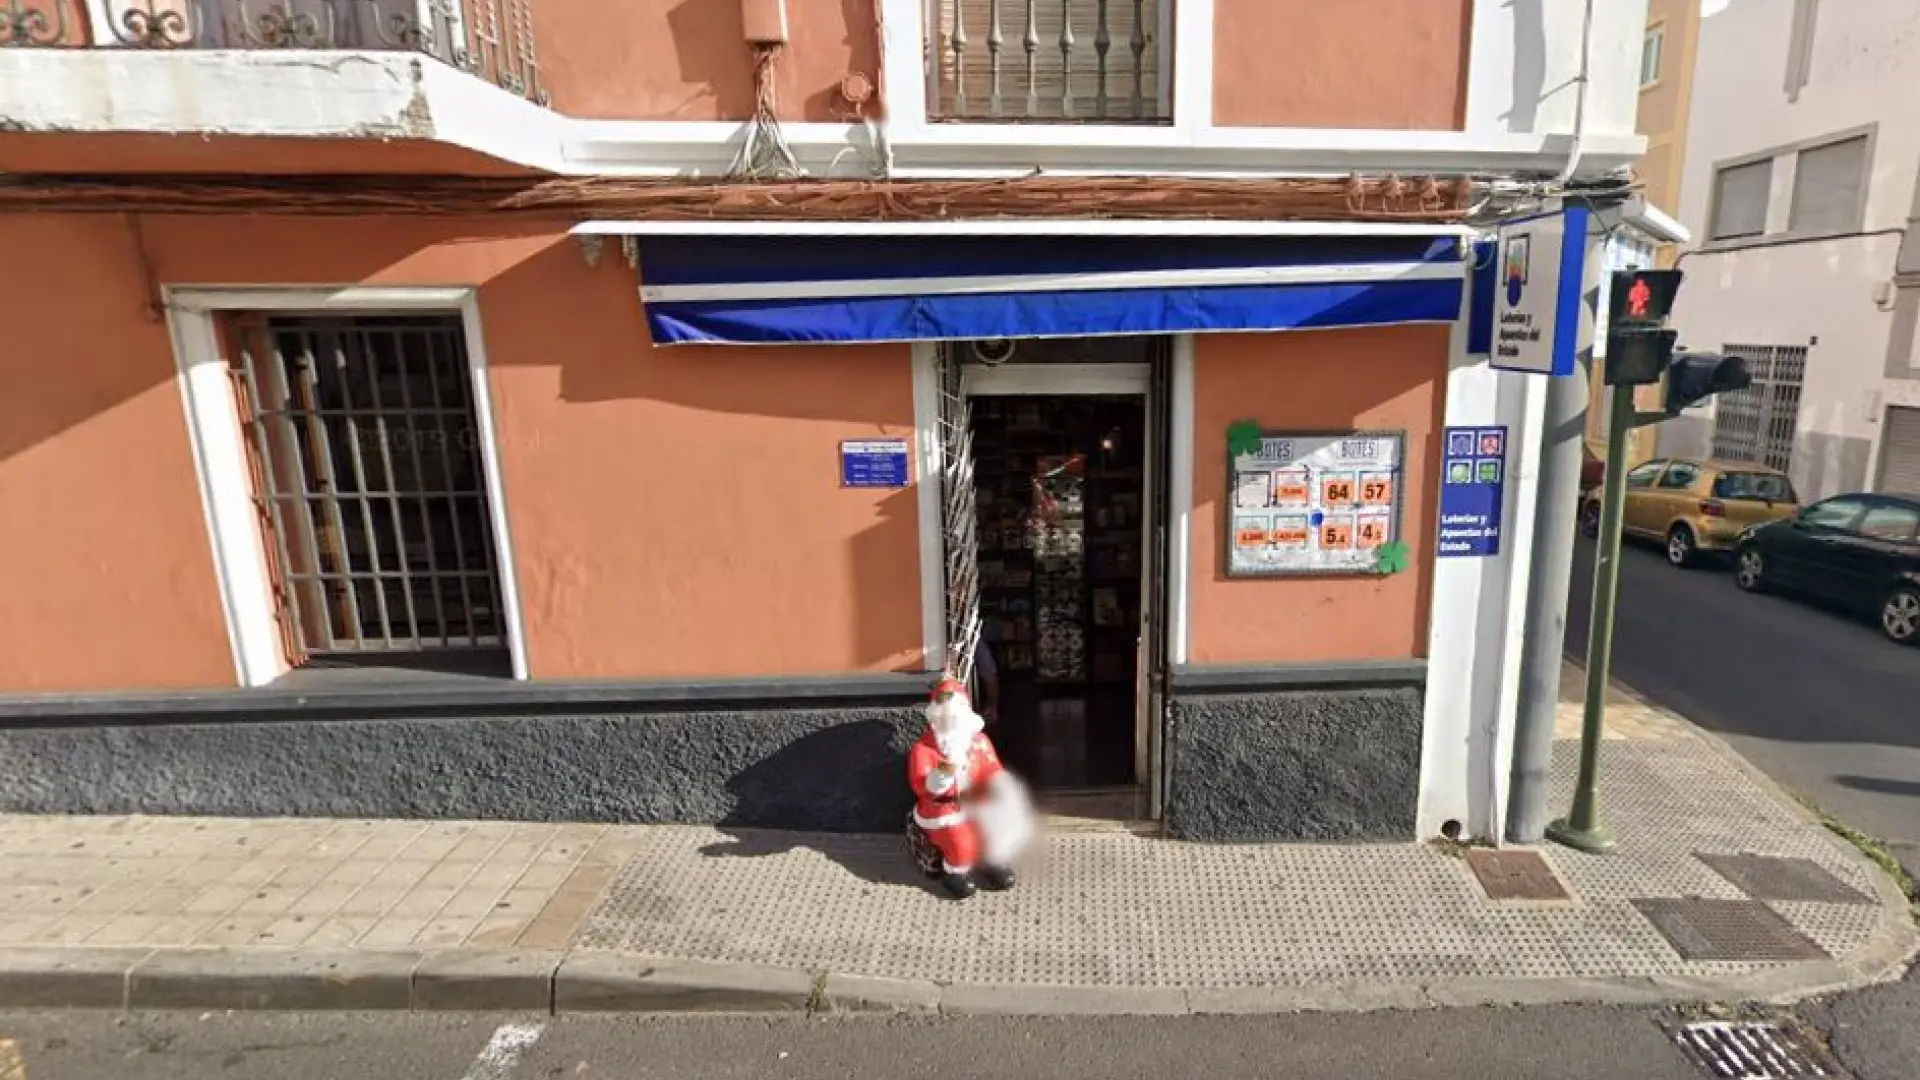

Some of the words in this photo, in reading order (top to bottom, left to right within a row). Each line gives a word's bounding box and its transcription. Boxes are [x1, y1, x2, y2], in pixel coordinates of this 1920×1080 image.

[1341, 441, 1374, 458] BOTES
[1327, 484, 1349, 500] 64
[1364, 483, 1385, 500] 57
[1440, 541, 1471, 551] Estado
